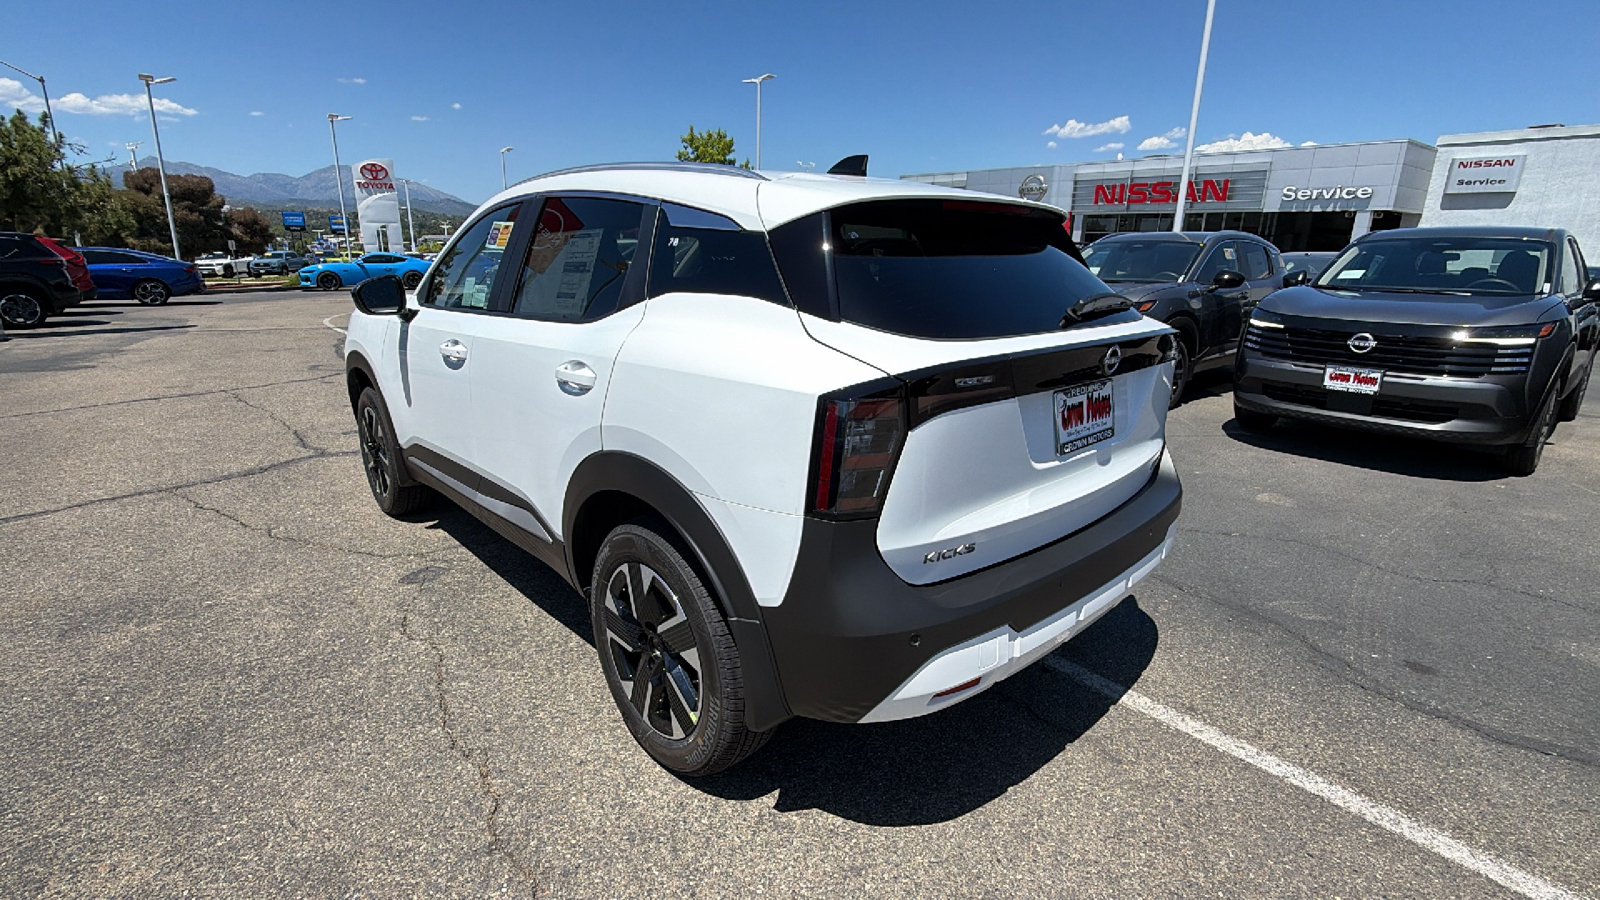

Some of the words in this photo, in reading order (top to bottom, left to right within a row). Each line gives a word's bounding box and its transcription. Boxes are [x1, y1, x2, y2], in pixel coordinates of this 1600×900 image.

[1457, 158, 1516, 169] NISSAN
[356, 181, 396, 191] TOYOTA
[1456, 177, 1507, 187] Service
[1093, 179, 1230, 205] NISSAN
[1281, 184, 1373, 201] Service
[1347, 340, 1377, 348] NISSAN
[1063, 437, 1088, 453] CROWN
[1087, 429, 1113, 445] MOTORS
[922, 542, 977, 565] KICKS
